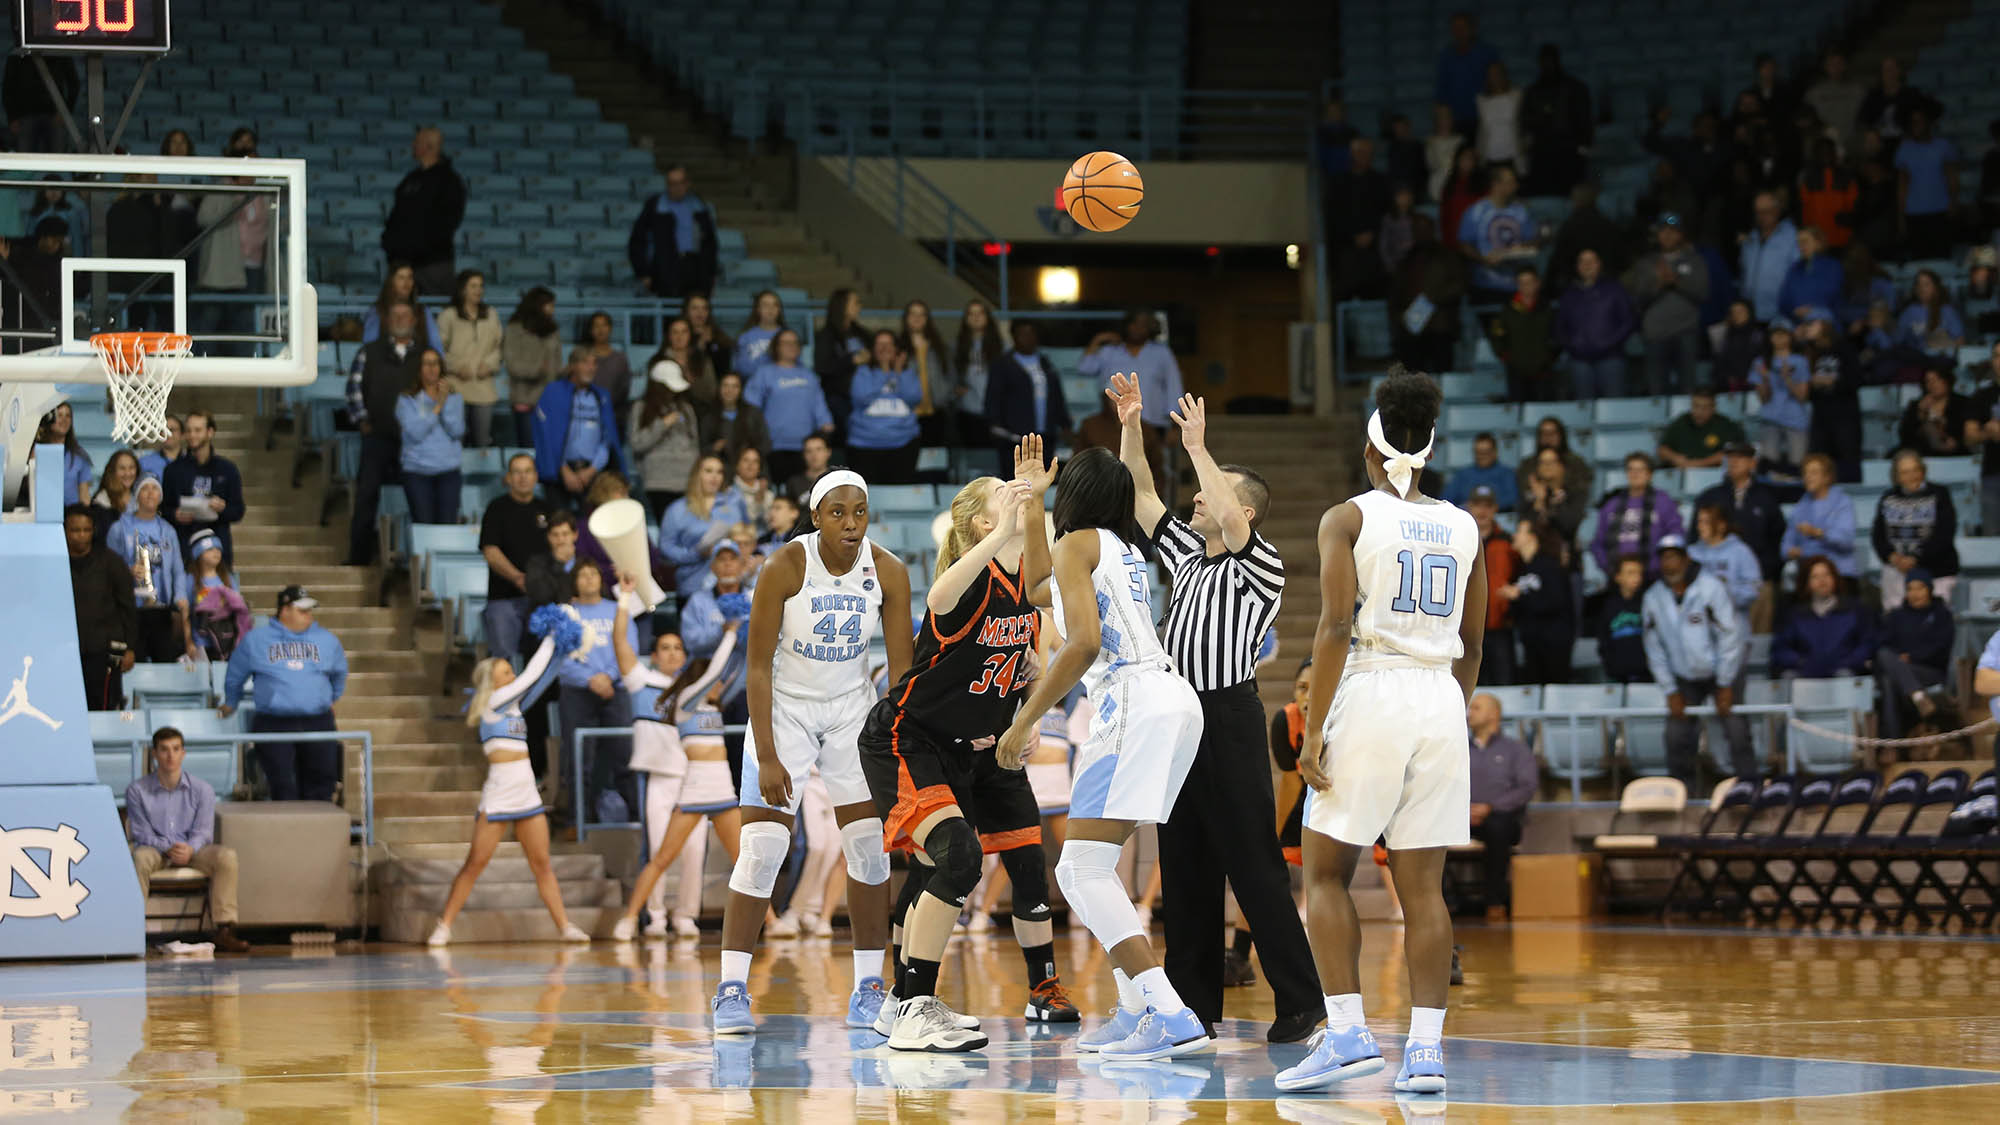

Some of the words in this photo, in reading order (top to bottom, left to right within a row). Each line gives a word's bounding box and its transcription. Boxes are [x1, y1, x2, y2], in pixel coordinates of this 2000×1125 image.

[1400, 520, 1452, 545] CHERRY
[1391, 550, 1458, 617] 10
[811, 594, 866, 614] NORTH
[813, 614, 862, 643] 44
[976, 612, 1033, 647] MERCE
[268, 642, 321, 664] CAROLINA
[969, 650, 1022, 698] 34
